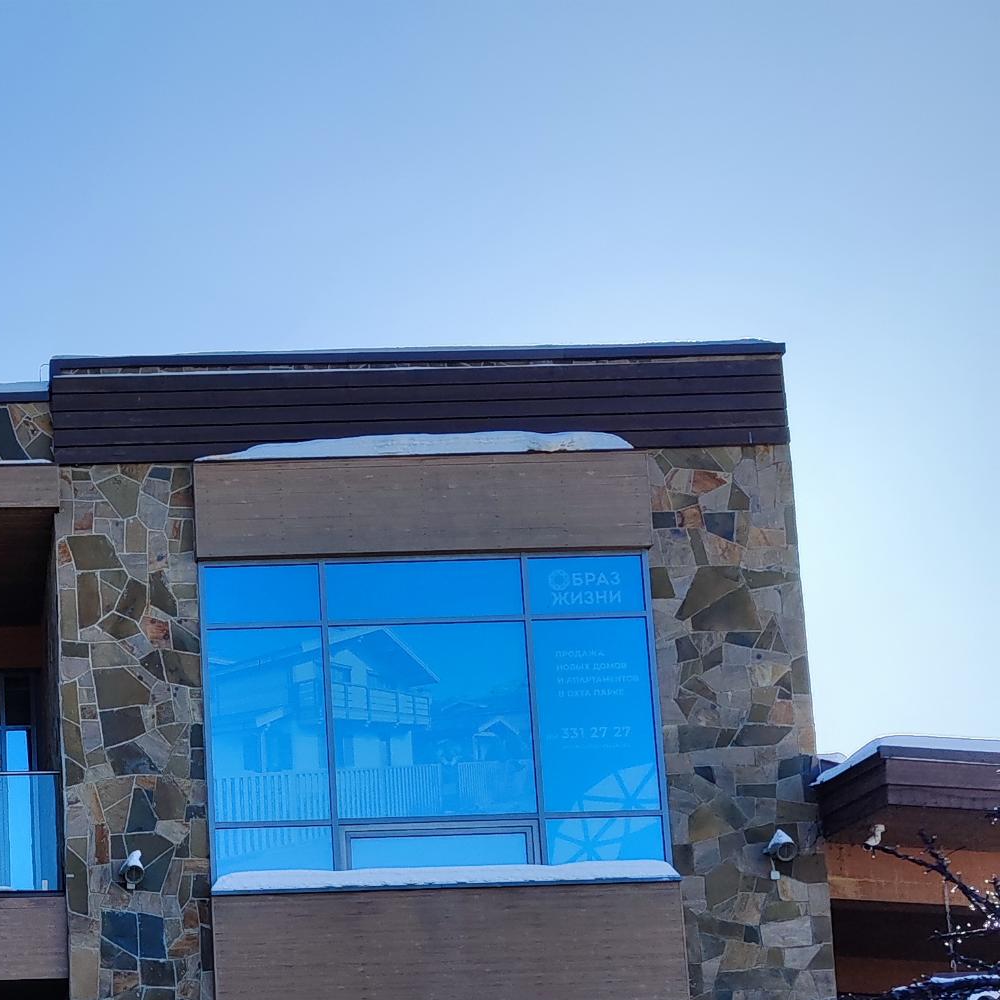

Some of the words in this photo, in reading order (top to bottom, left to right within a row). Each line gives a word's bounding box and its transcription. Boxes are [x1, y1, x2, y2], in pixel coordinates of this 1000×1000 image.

[548, 569, 621, 591] ОБРАЗ
[551, 590, 622, 606] ЖИЗНИ
[561, 727, 584, 739] 331
[590, 726, 608, 738] 27
[613, 726, 632, 738] 27
